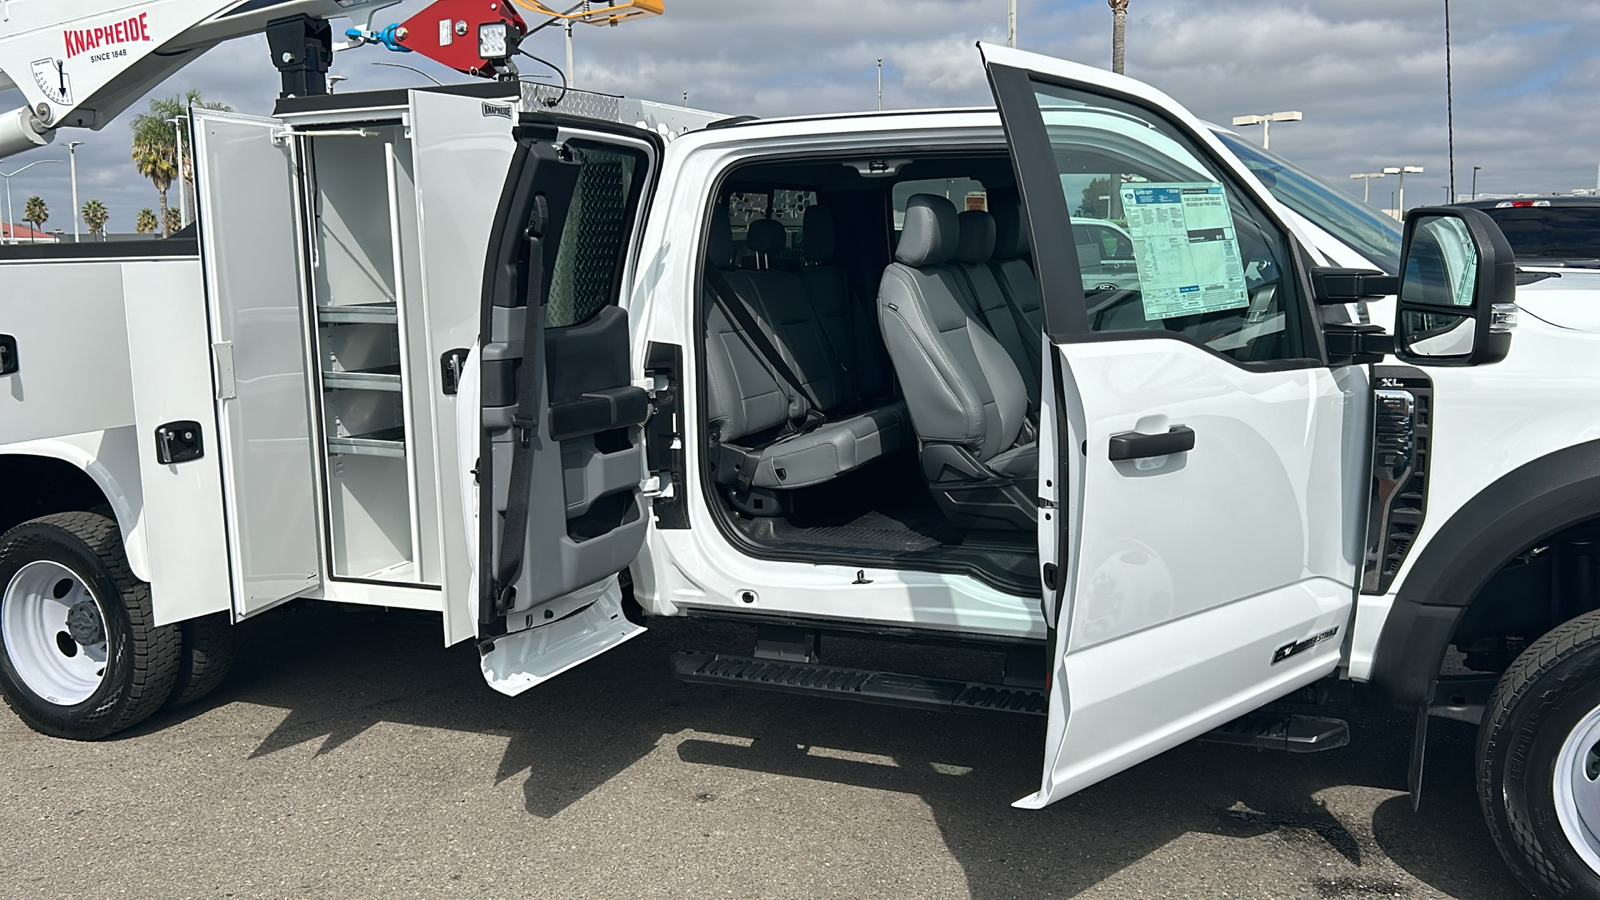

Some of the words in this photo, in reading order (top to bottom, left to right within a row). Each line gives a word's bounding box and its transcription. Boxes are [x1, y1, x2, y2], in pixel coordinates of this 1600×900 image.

[63, 12, 151, 59] KNAPHEIDE
[90, 52, 110, 64] SINCE
[111, 49, 128, 59] 1848
[484, 104, 511, 117] KNAPHEIDE
[1381, 378, 1404, 387] XL
